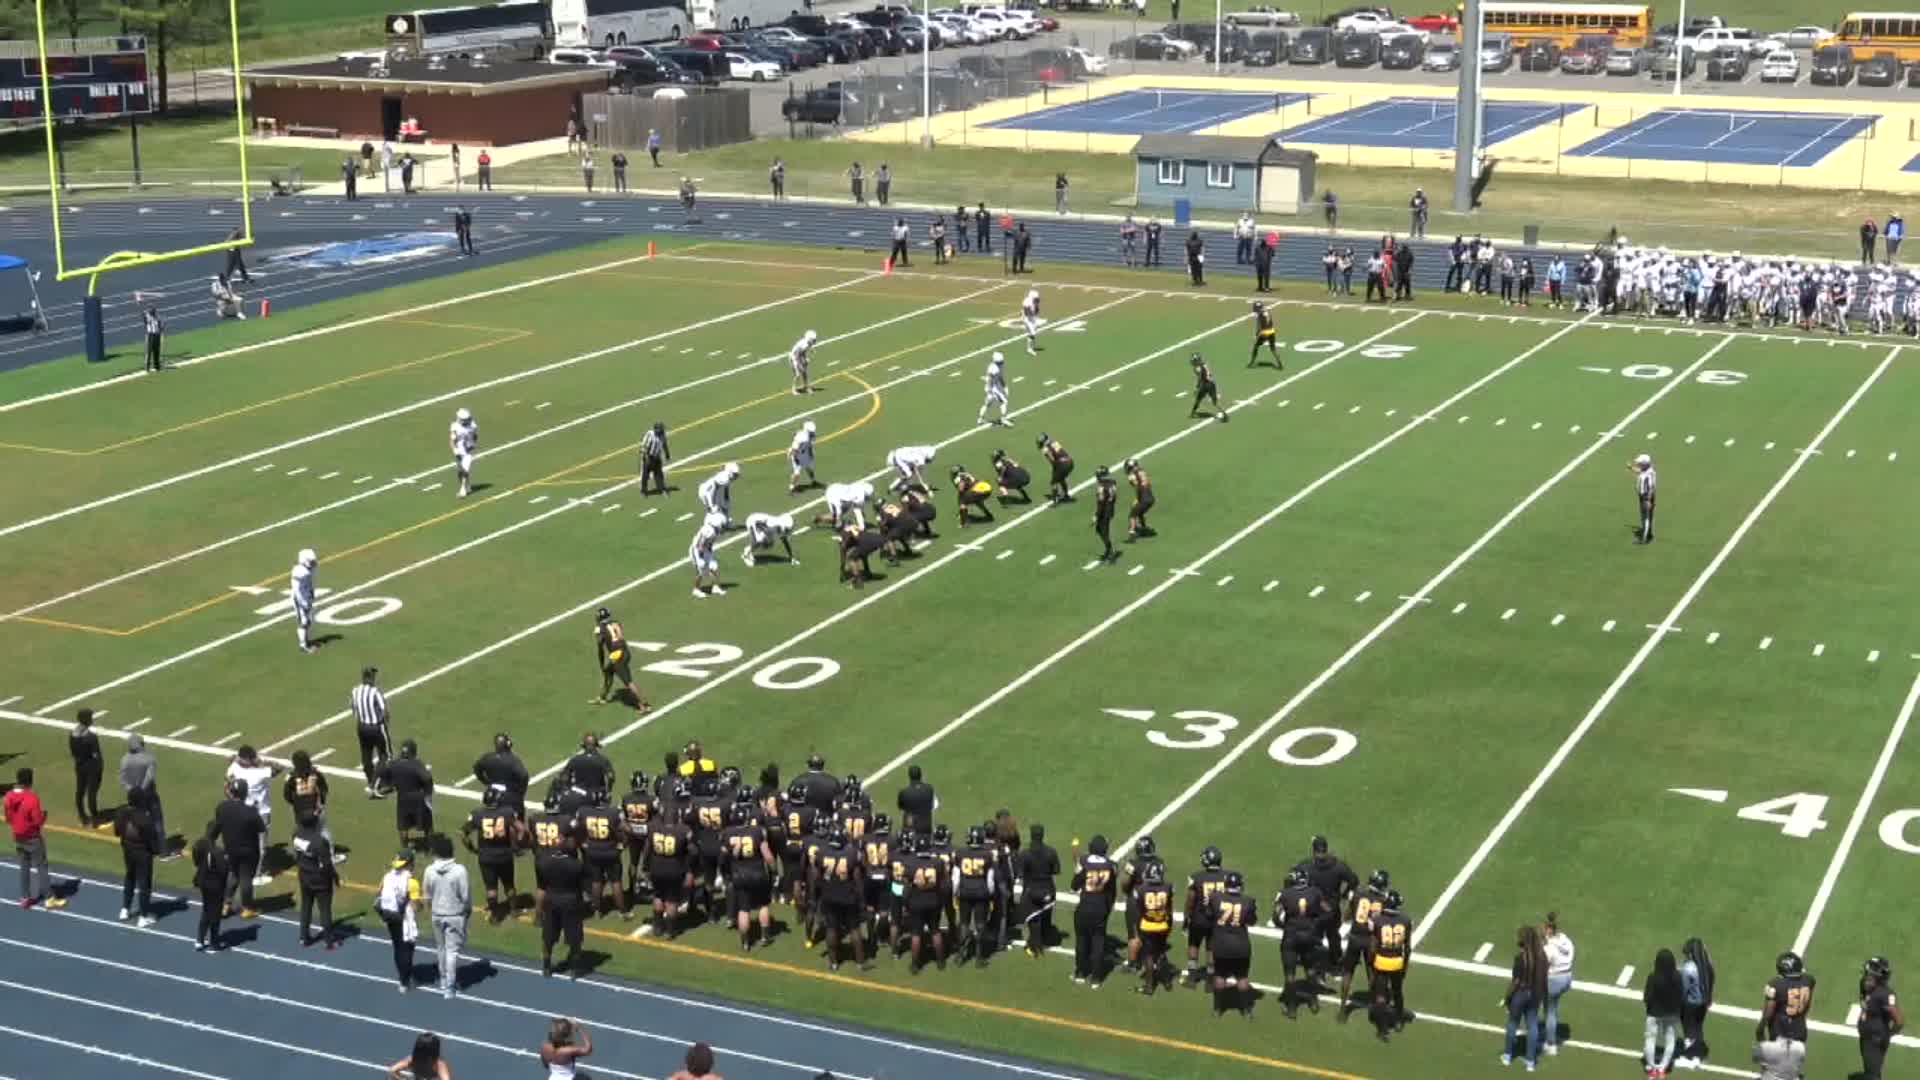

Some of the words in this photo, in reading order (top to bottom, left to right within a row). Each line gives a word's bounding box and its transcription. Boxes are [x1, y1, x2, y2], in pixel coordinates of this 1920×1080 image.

[1146, 710, 1358, 766] 30
[481, 816, 506, 840] 54
[1219, 901, 1243, 926] 71
